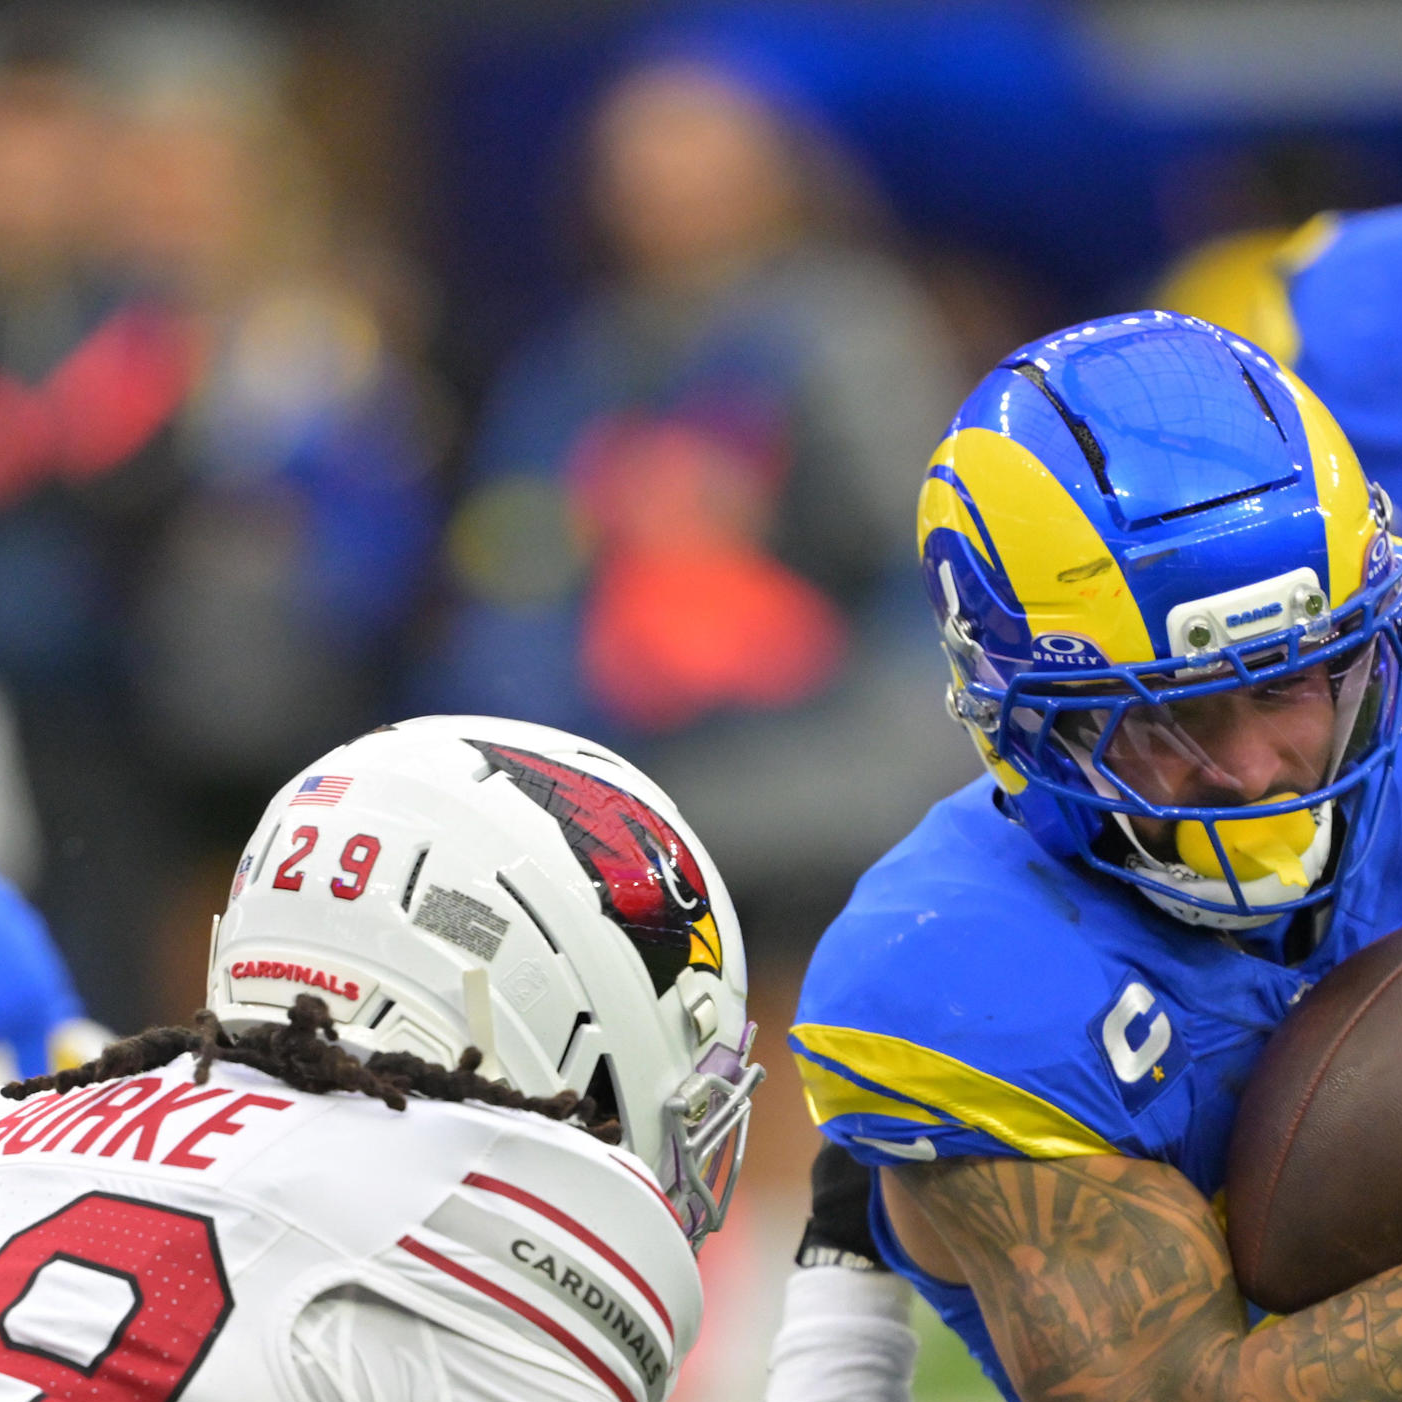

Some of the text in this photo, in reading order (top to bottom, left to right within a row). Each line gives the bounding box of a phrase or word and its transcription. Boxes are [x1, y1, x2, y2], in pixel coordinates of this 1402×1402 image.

[1032, 651, 1099, 665] OAKLEY
[272, 824, 381, 901] 29
[231, 960, 360, 1001] CARDINALS
[510, 1239, 663, 1387] CARDINALS
